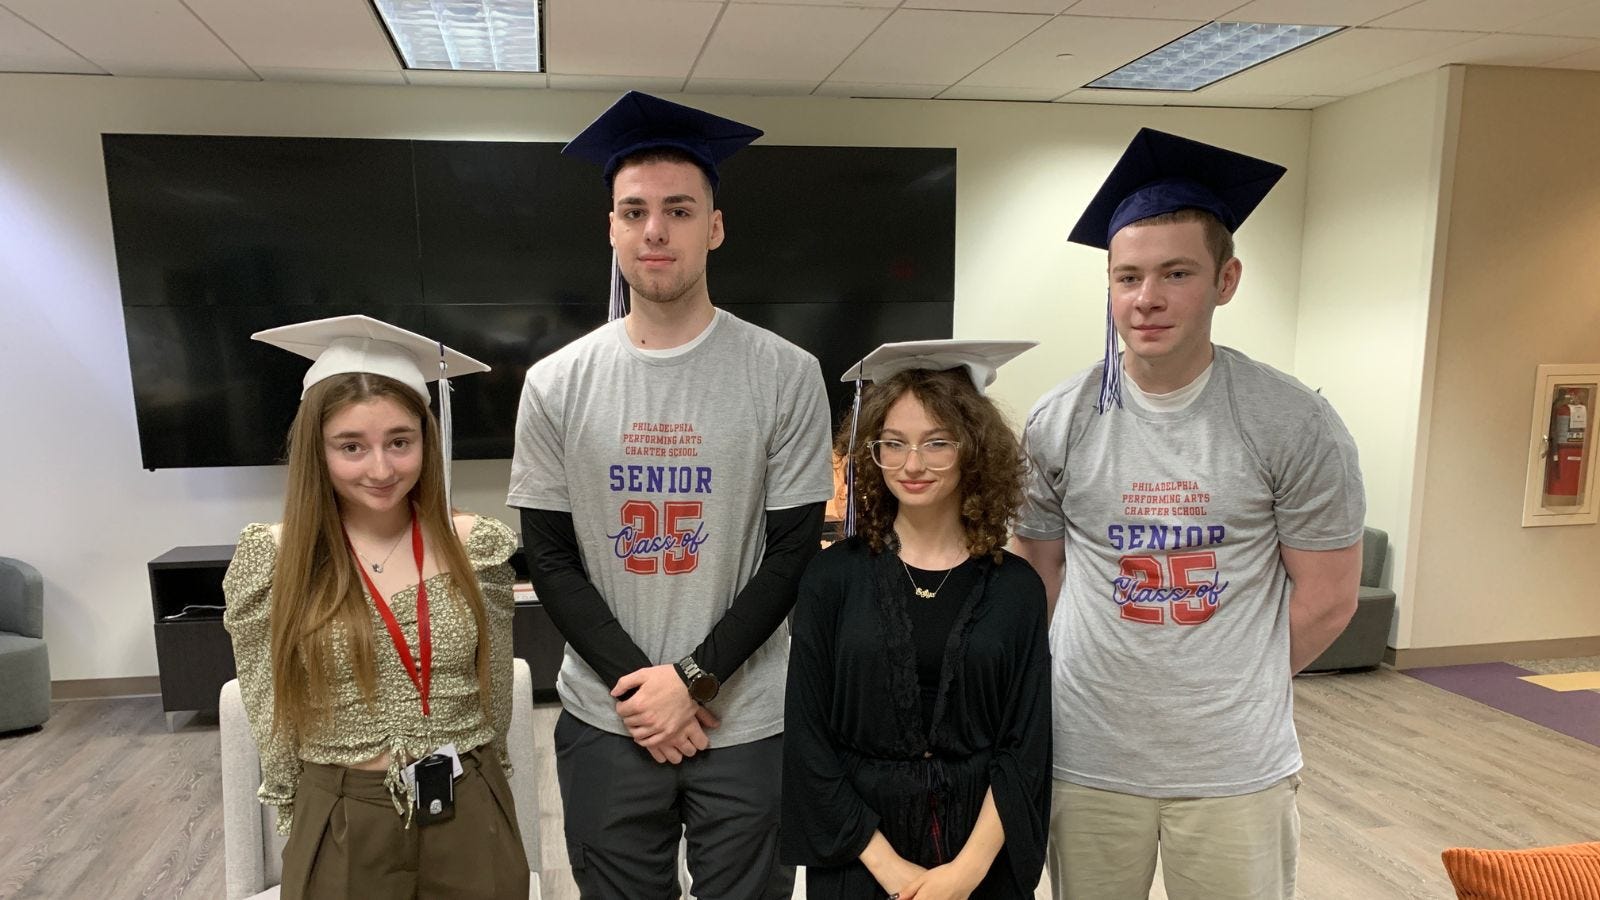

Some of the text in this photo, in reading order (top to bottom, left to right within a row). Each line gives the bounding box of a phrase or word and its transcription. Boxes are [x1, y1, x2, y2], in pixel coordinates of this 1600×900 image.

[632, 422, 694, 432] PHILADELPHIA
[623, 433, 702, 445] PERFORMING ARTS
[625, 446, 698, 457] CHARTER SCHOOL
[609, 465, 712, 493] SENIOR
[1132, 481, 1199, 491] PHILADELPHIA
[1122, 493, 1210, 504] PERFORMING ARTS
[1124, 506, 1207, 516] CHARTER SCHOOL
[607, 521, 709, 559] Class of
[620, 500, 703, 575] 25
[1108, 524, 1225, 550] SENIOR
[1111, 571, 1229, 605] Class of
[1118, 552, 1220, 625] 25
